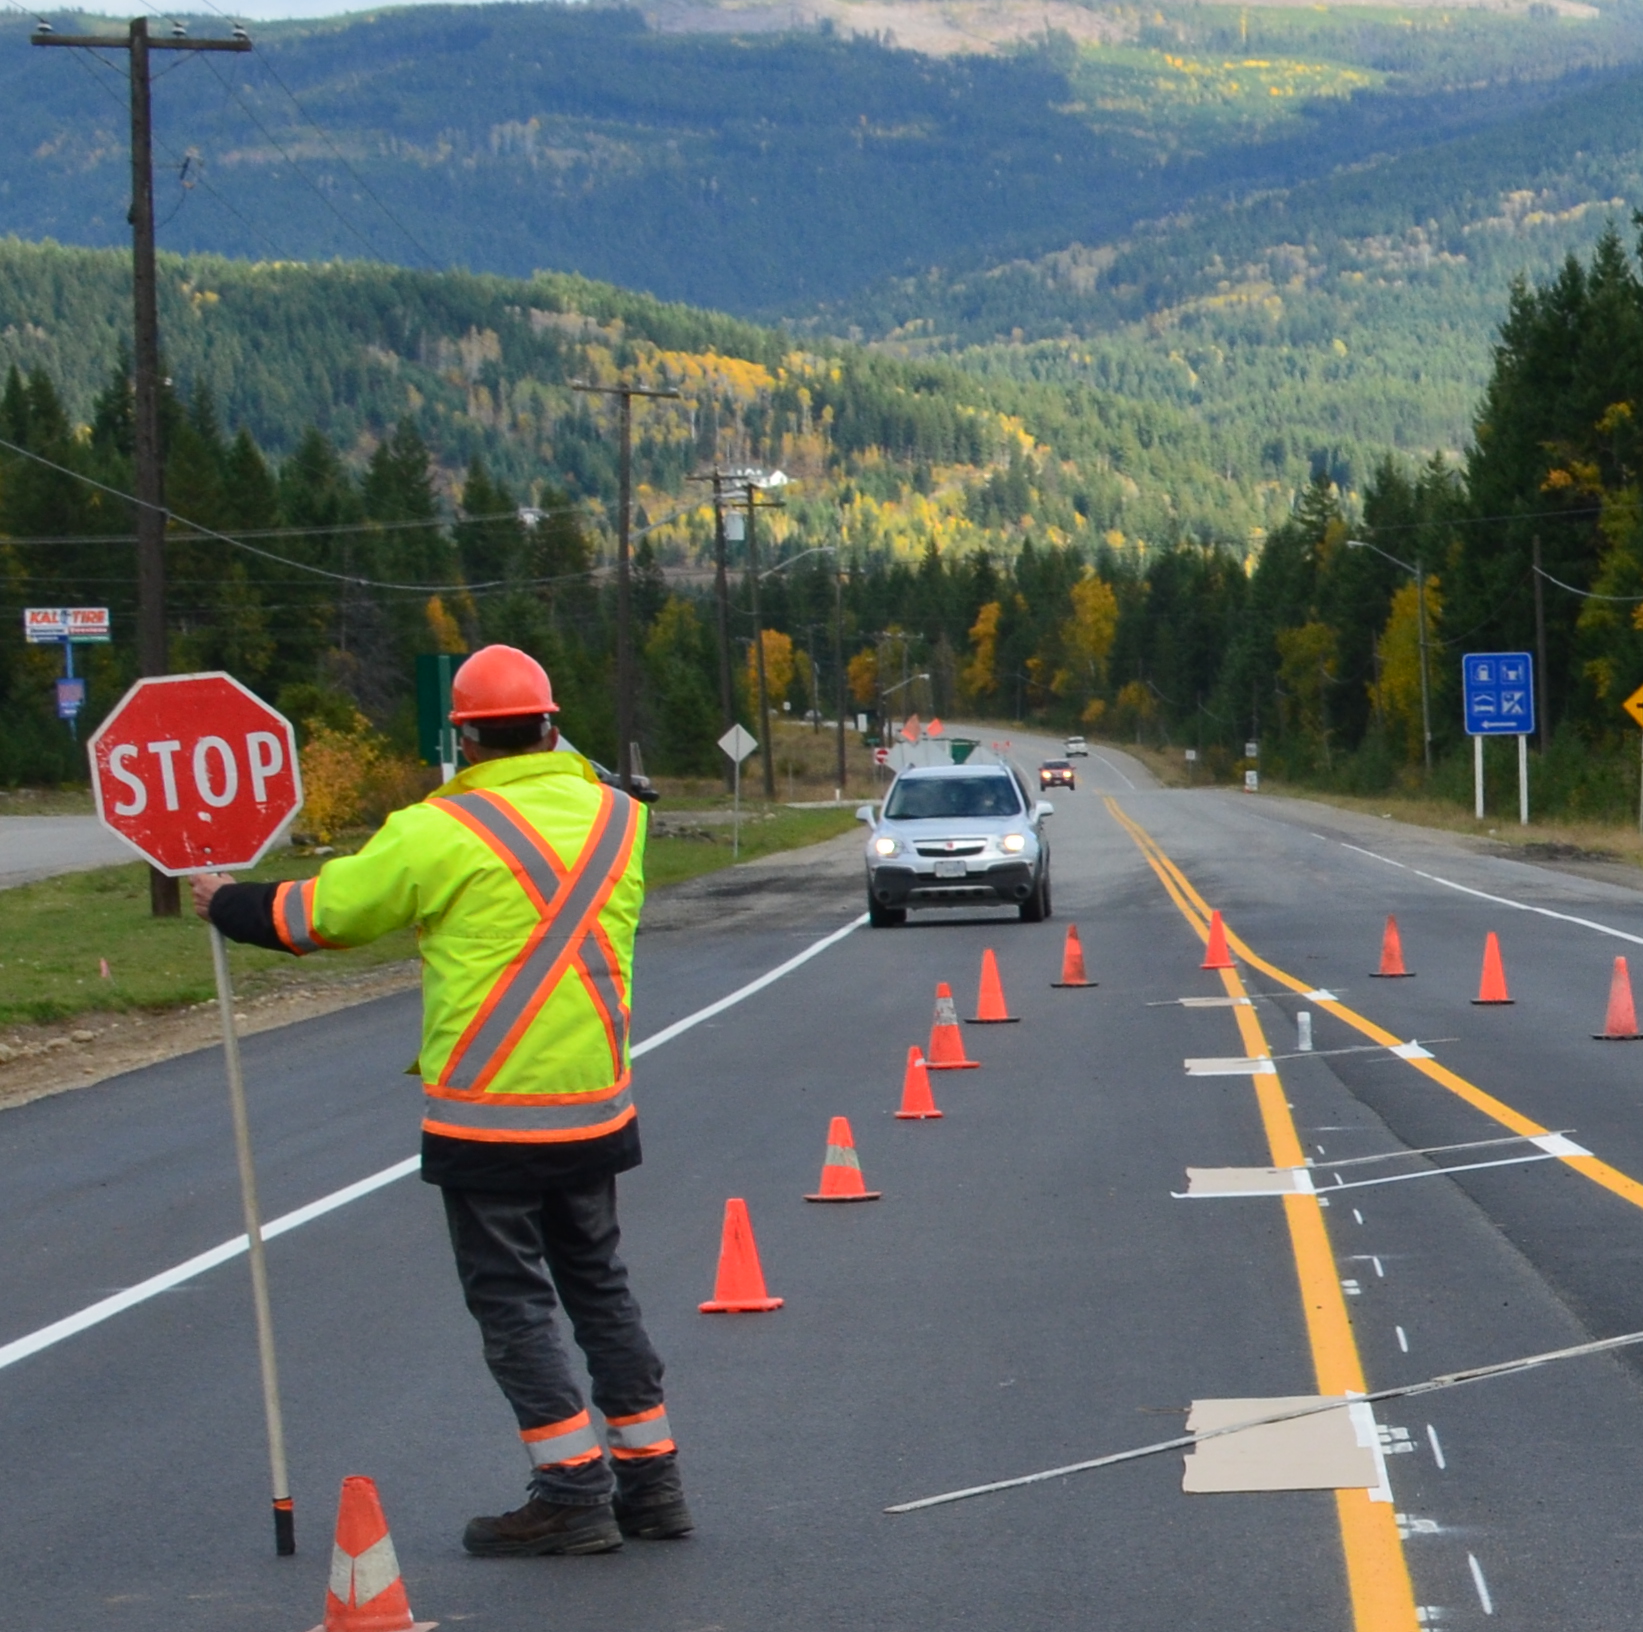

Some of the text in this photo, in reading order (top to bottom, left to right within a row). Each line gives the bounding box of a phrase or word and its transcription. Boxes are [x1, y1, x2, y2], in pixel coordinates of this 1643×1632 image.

[29, 610, 105, 624] KAL TIRE
[109, 731, 283, 816] STOP
